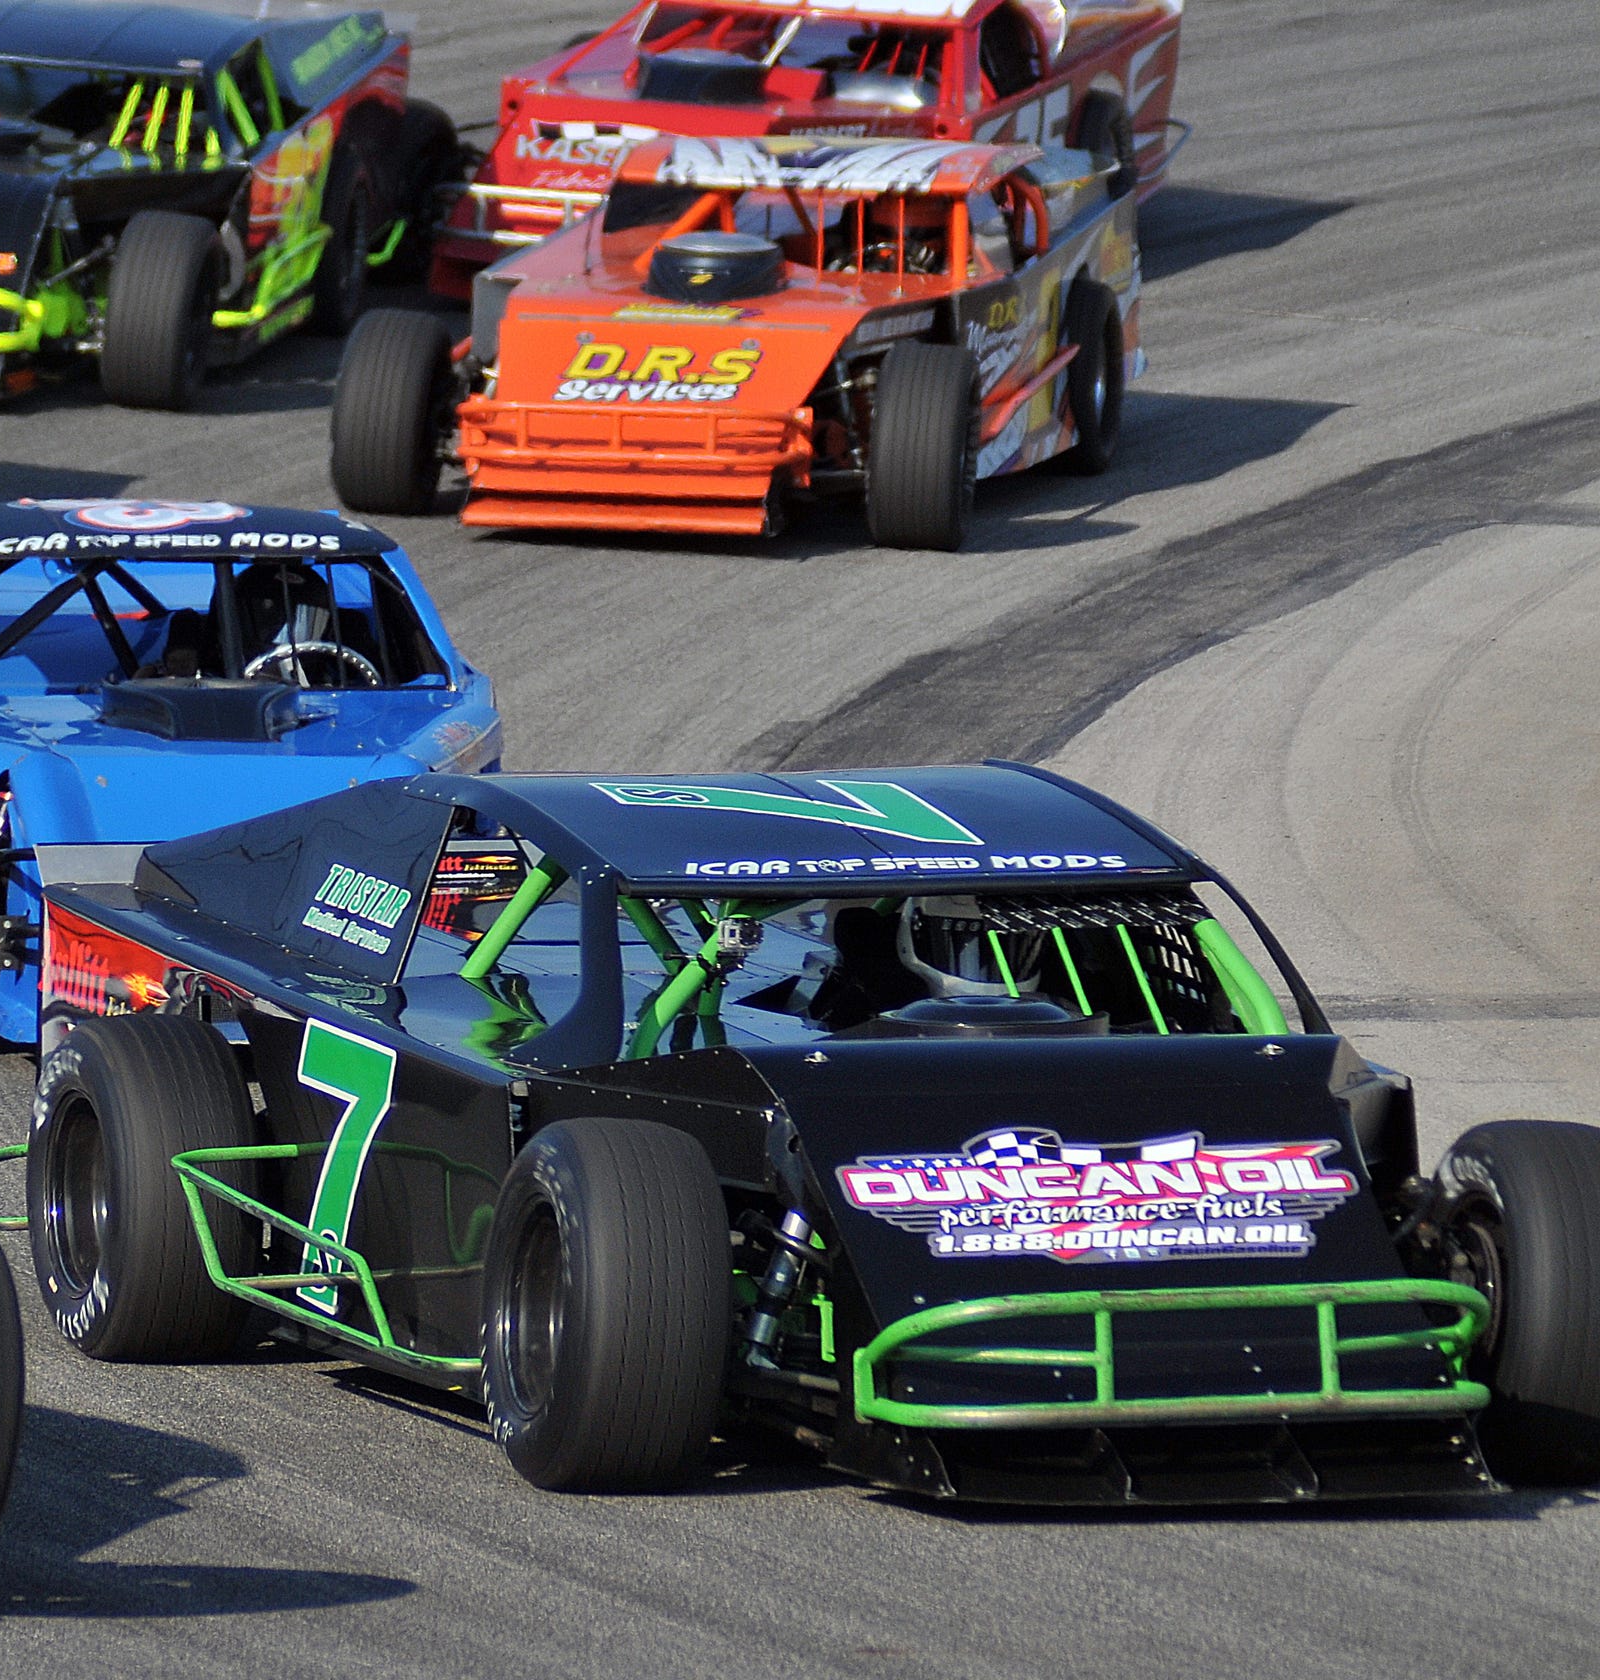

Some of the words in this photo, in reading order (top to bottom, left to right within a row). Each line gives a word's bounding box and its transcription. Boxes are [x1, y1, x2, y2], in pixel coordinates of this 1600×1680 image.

[553, 379, 738, 401] Services
[75, 532, 130, 549] TOP
[133, 533, 221, 549] SPEED
[230, 532, 341, 551] MODS
[684, 860, 791, 876] ICAR
[873, 856, 981, 871] SPEED
[990, 853, 1127, 870] MODS
[313, 862, 413, 930] TRISTAR
[302, 906, 349, 938] Medical
[343, 920, 393, 955] Services
[297, 1017, 397, 1315] 7
[845, 1160, 1204, 1206] DUNCAN
[1217, 1155, 1353, 1193] OIL
